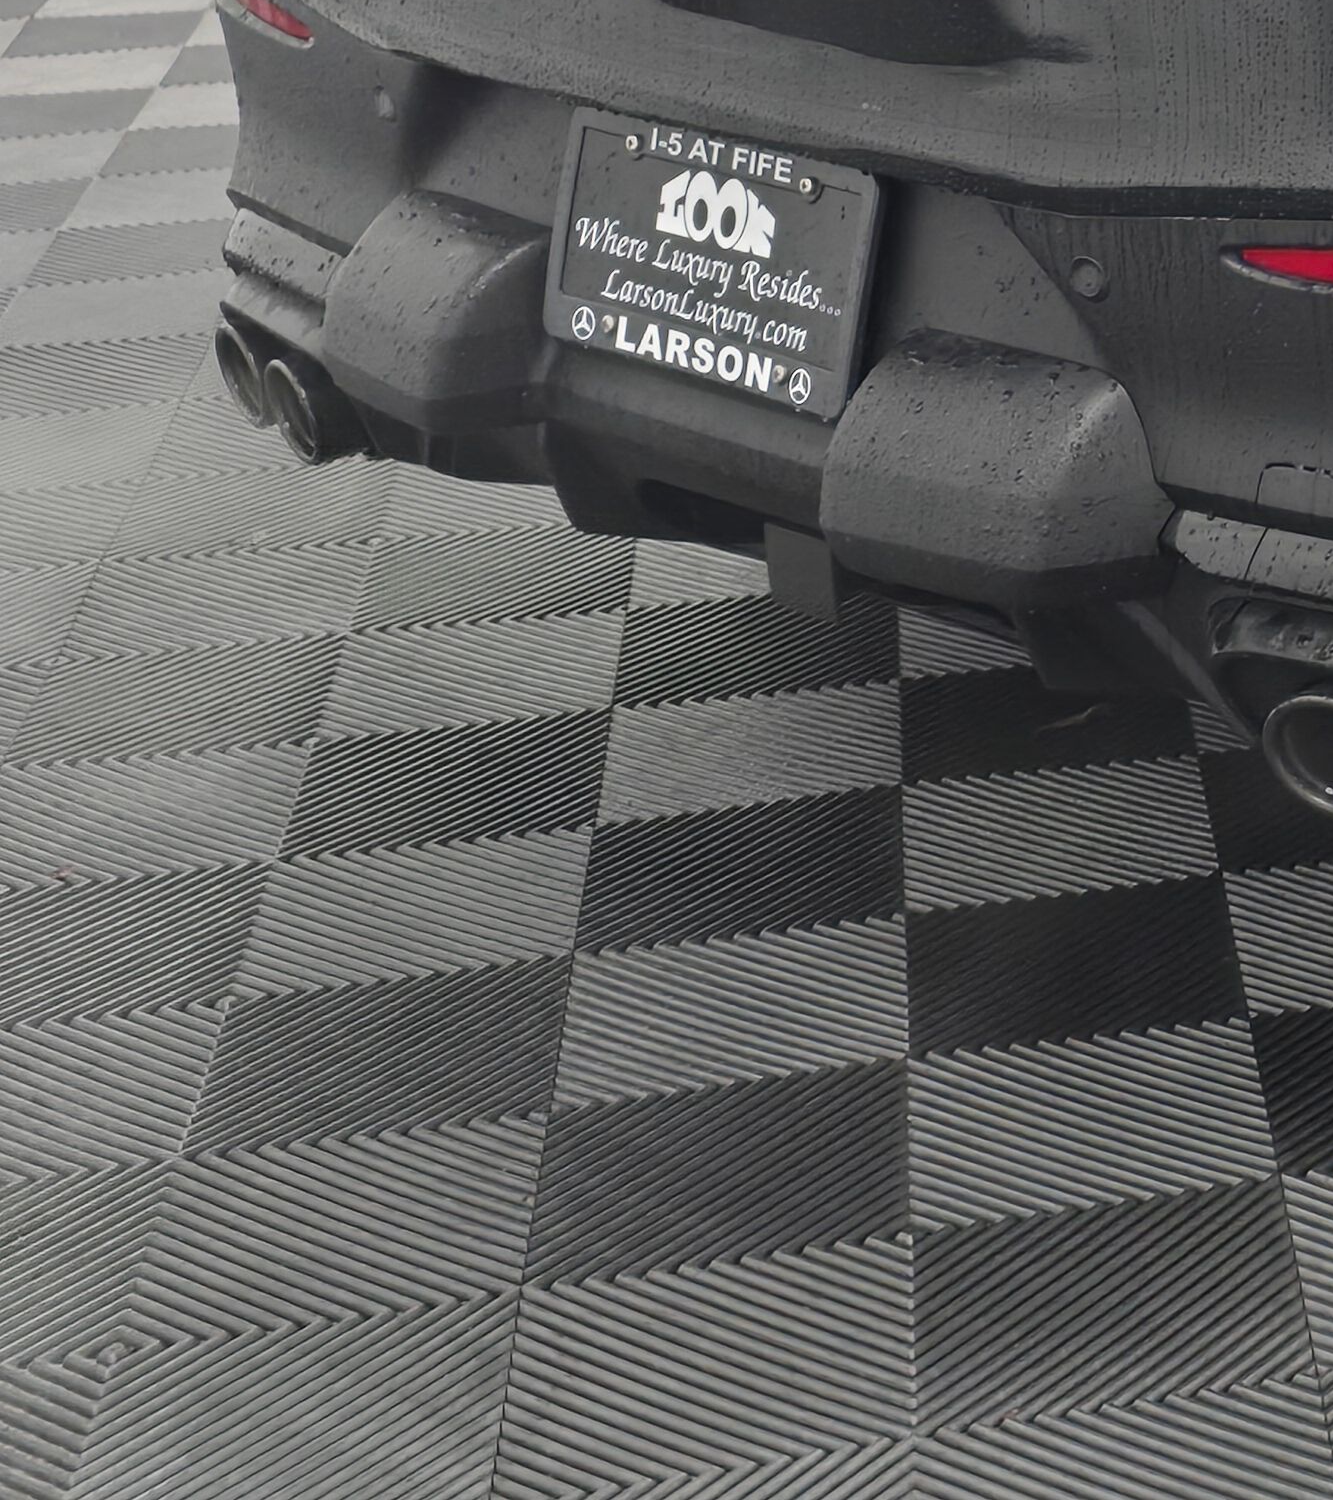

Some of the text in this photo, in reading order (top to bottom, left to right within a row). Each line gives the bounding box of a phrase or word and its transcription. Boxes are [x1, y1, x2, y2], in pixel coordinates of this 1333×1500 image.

[649, 127, 793, 184] I-5 AT FIFE
[575, 216, 649, 264] Where
[651, 238, 733, 298] Luxury
[600, 268, 808, 352] LarsonLuxury.com
[614, 315, 773, 392] LARSON
